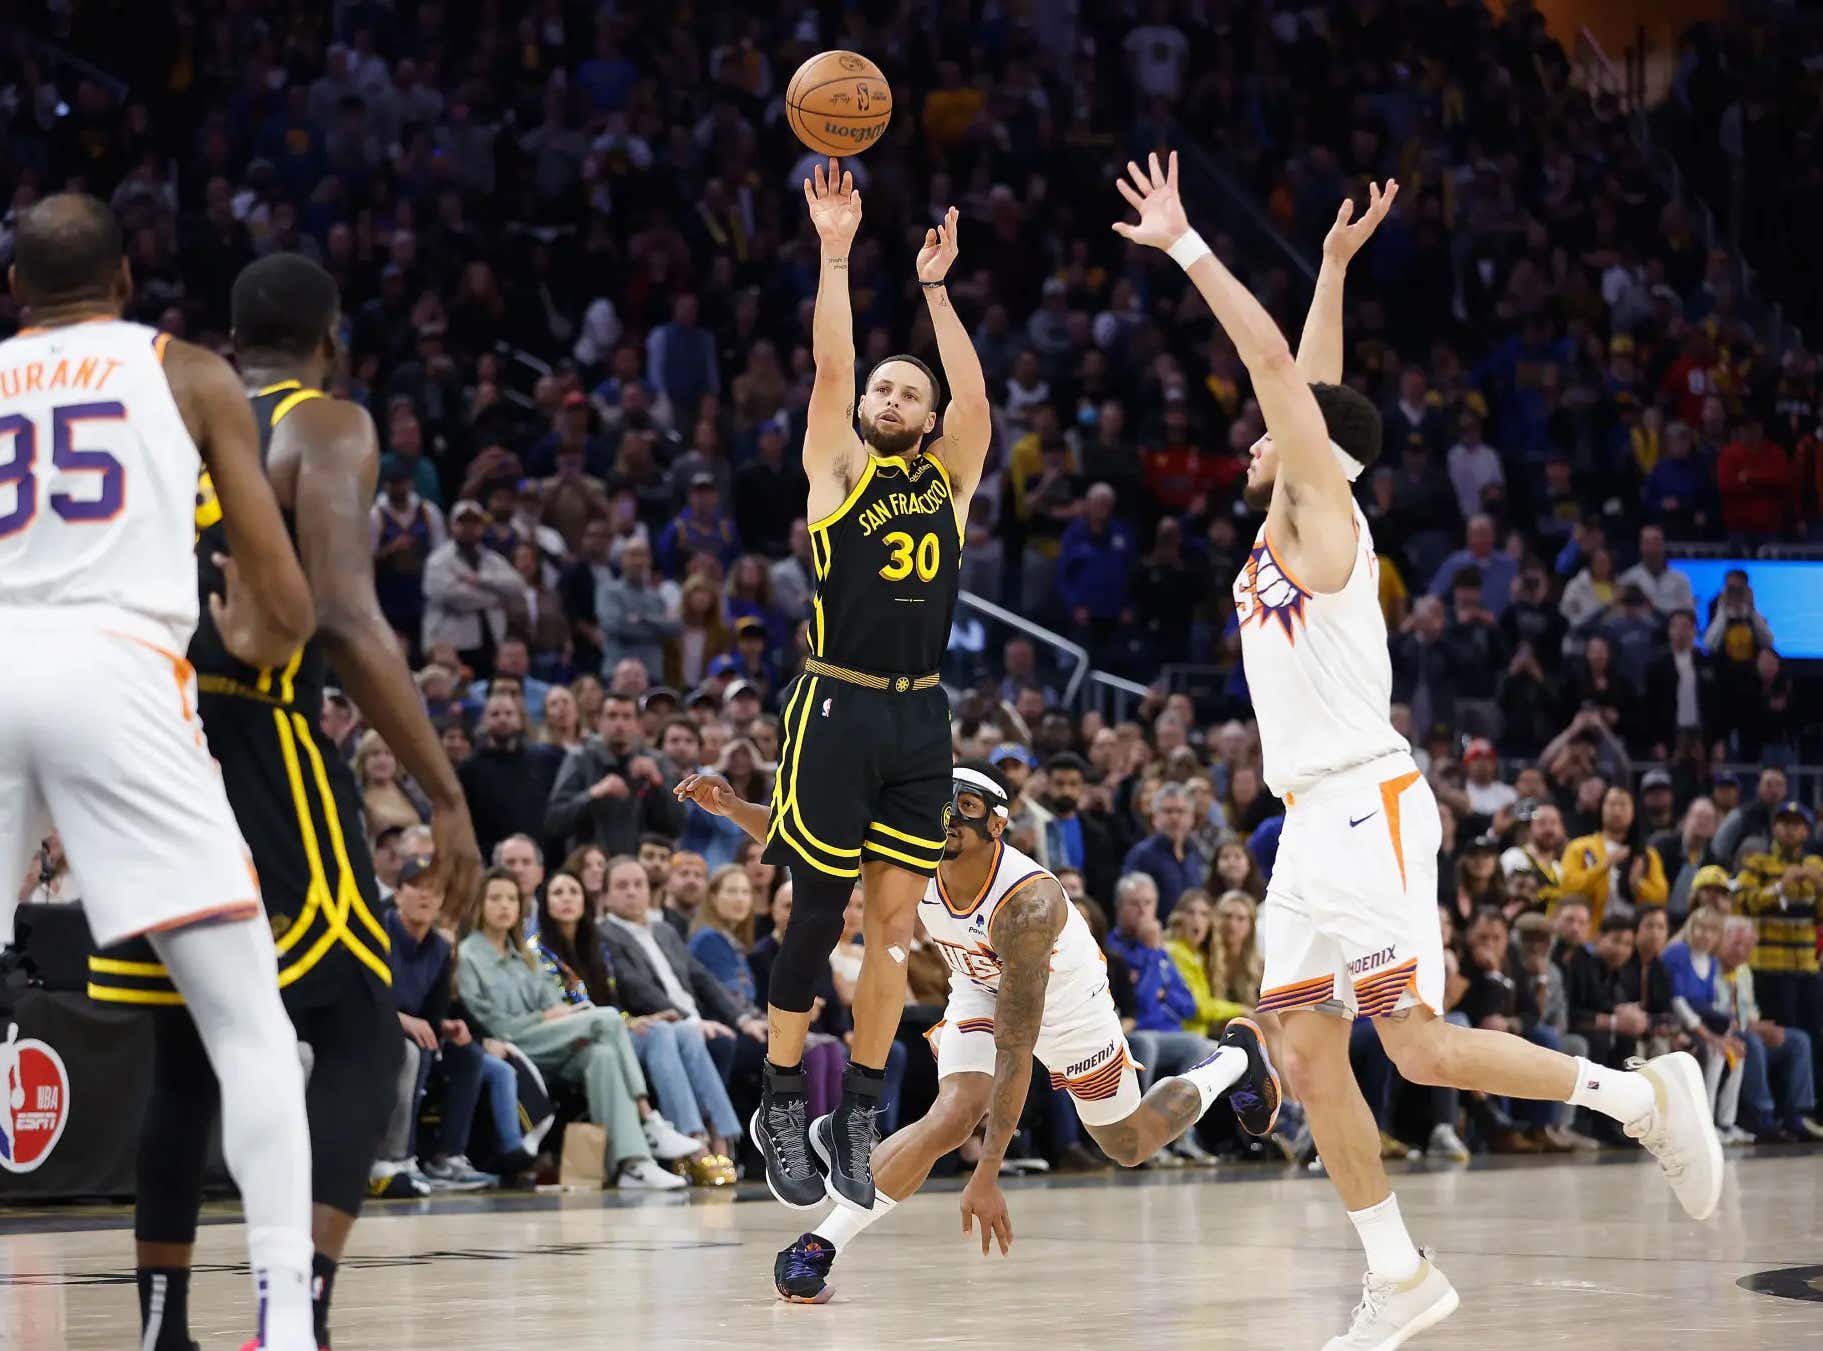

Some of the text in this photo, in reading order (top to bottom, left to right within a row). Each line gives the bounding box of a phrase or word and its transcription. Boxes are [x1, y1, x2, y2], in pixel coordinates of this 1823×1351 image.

[0, 357, 124, 398] URANT
[858, 479, 948, 537] SAN FRACISCO
[878, 531, 940, 583] 30
[1066, 1040, 1116, 1077] PHOENIX
[37, 1085, 59, 1111] NBA
[15, 1112, 57, 1131] ESPN
